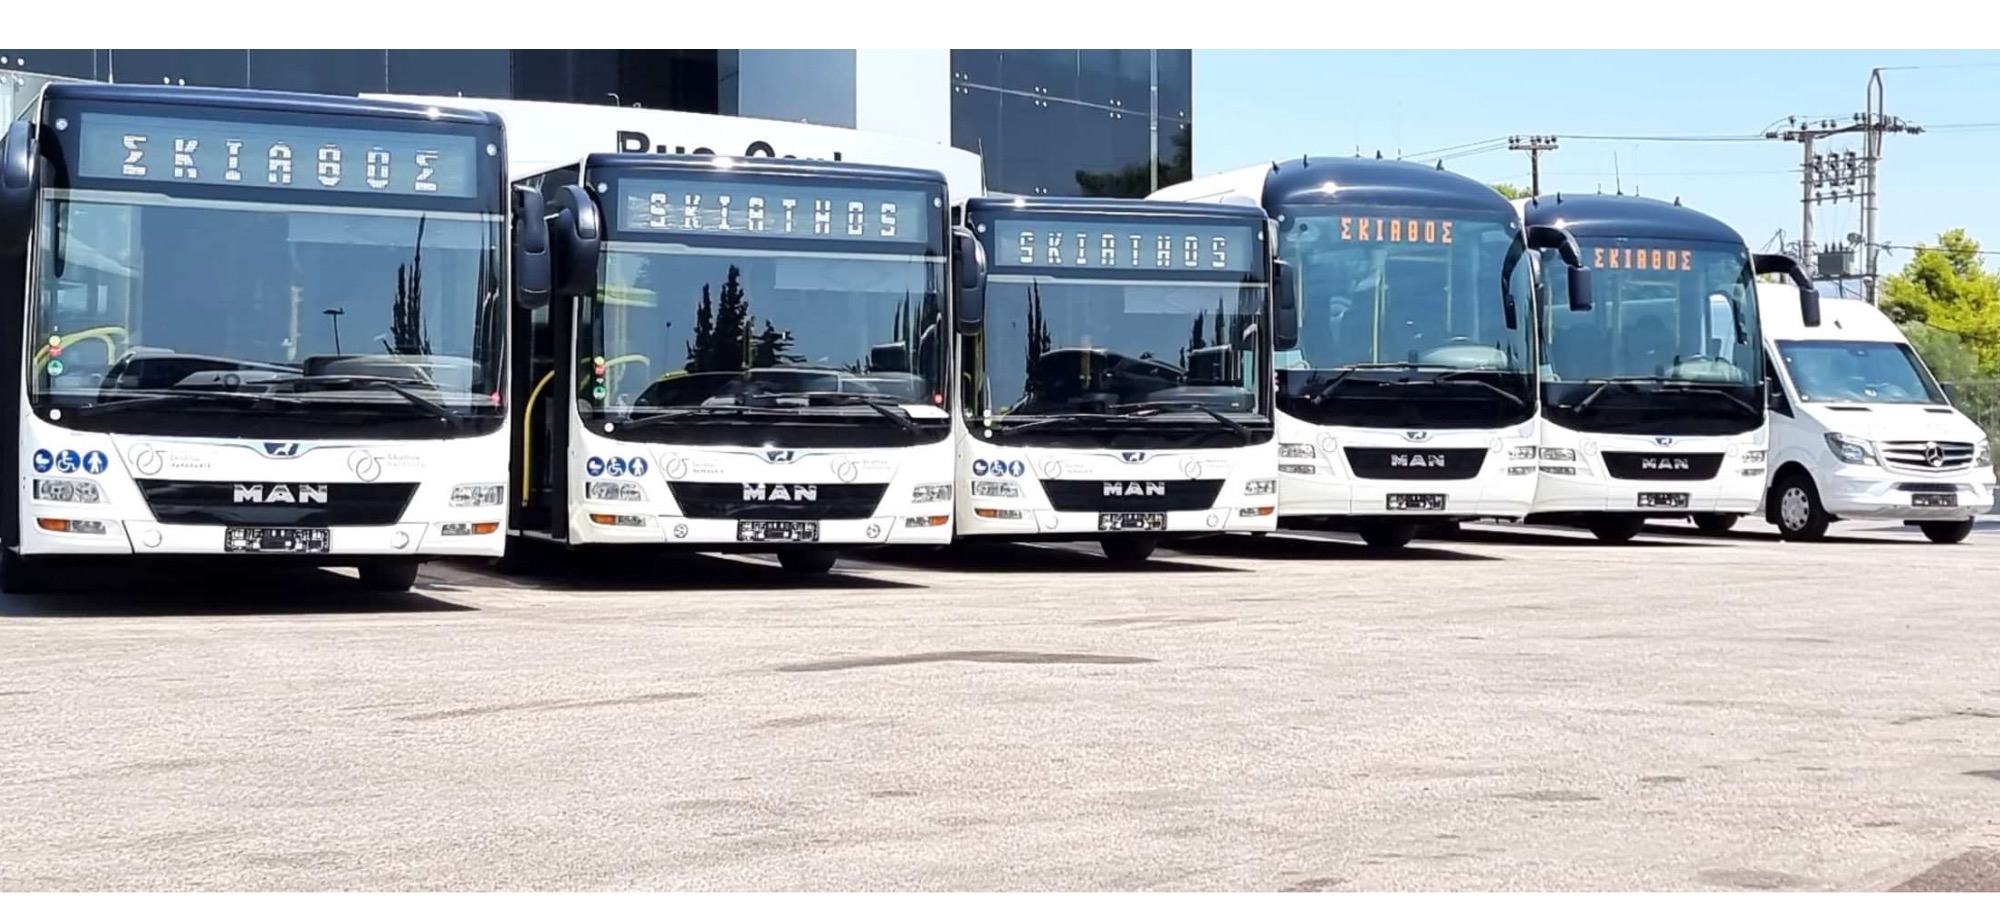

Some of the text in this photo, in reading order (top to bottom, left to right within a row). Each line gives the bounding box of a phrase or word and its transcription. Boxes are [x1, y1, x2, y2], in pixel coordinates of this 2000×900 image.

[121, 135, 440, 192] ΣΚΙΑΘΟΣ
[648, 192, 898, 237] SKIATHOS
[1339, 216, 1454, 244] ΣΚΙΑΘΟΣ
[1019, 231, 1227, 268] SKIATHOS
[1594, 247, 1693, 271] ΣΚΙΑΘΟΣ
[1390, 454, 1445, 467] MAN
[1642, 457, 1689, 470] MAN
[233, 484, 328, 503] MAN
[742, 483, 818, 502] MAN
[1103, 481, 1165, 496] MAN
